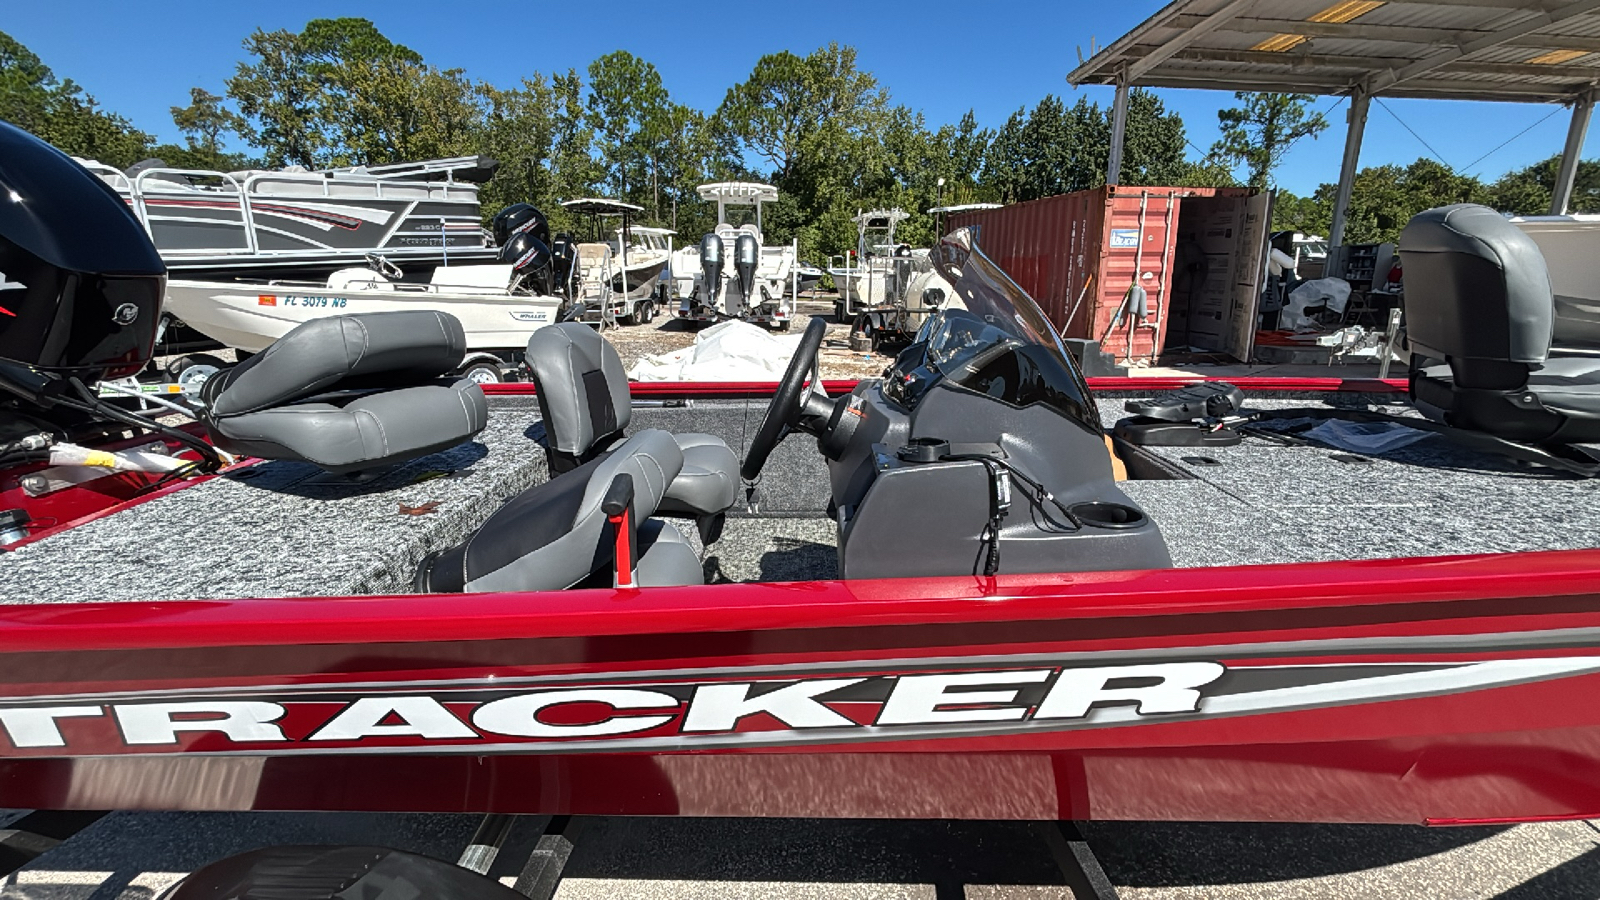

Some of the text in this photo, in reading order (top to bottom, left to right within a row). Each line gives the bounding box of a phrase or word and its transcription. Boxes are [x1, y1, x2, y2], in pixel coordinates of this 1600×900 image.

[284, 295, 297, 306] FL
[302, 296, 327, 307] 3079
[0, 661, 1226, 748] TRACKER
